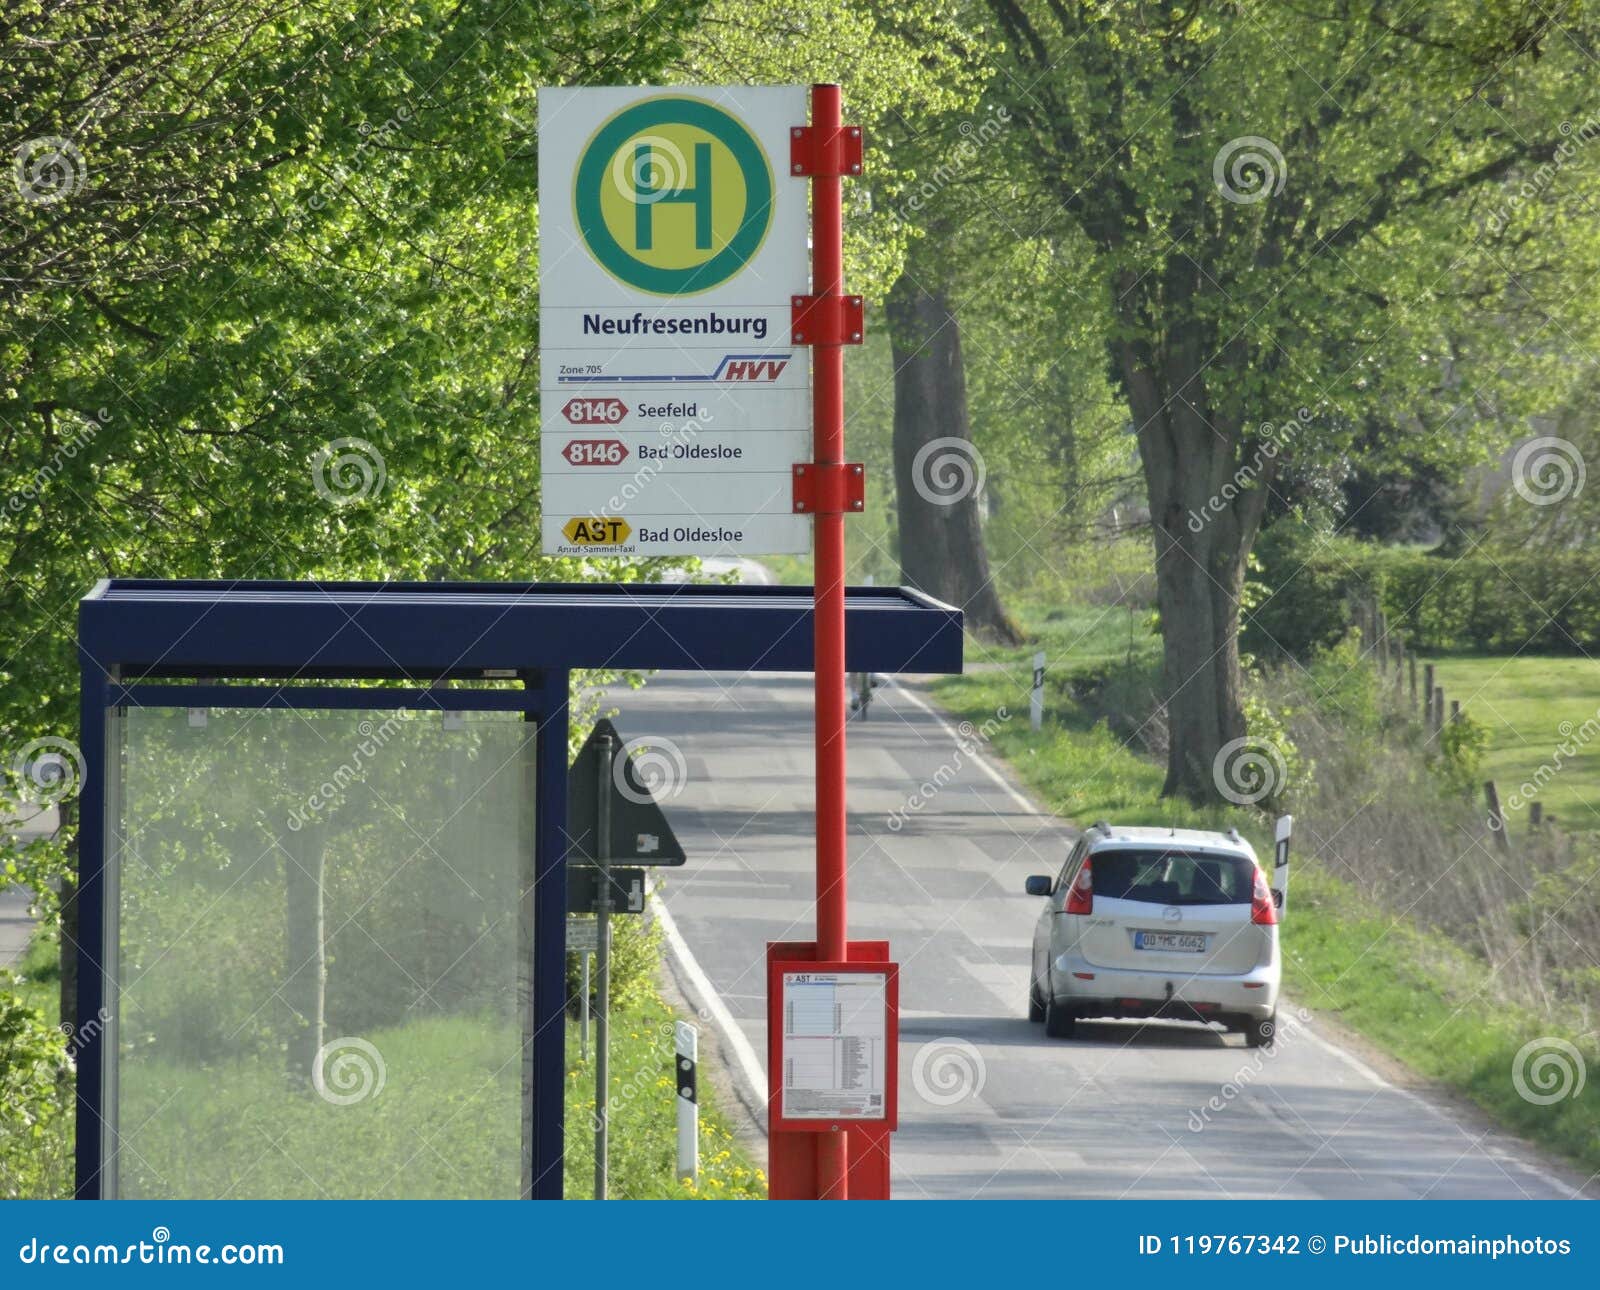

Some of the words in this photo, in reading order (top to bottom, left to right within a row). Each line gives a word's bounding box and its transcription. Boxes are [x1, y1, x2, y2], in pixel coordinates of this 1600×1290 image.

[635, 142, 713, 250] H
[583, 312, 768, 339] Neufresenburg
[559, 364, 583, 375] Zone
[585, 364, 603, 375] 705
[725, 361, 788, 381] HVV
[568, 401, 622, 421] 8146
[638, 402, 698, 418] Seefeld
[568, 443, 622, 463] 8146
[638, 445, 669, 460] Bad
[672, 444, 743, 460] Oldesloe
[573, 521, 623, 542] AST
[639, 527, 669, 543] Bad
[673, 527, 743, 543] Oldesloe
[557, 545, 636, 553] Anruf-Sammel-Taxi
